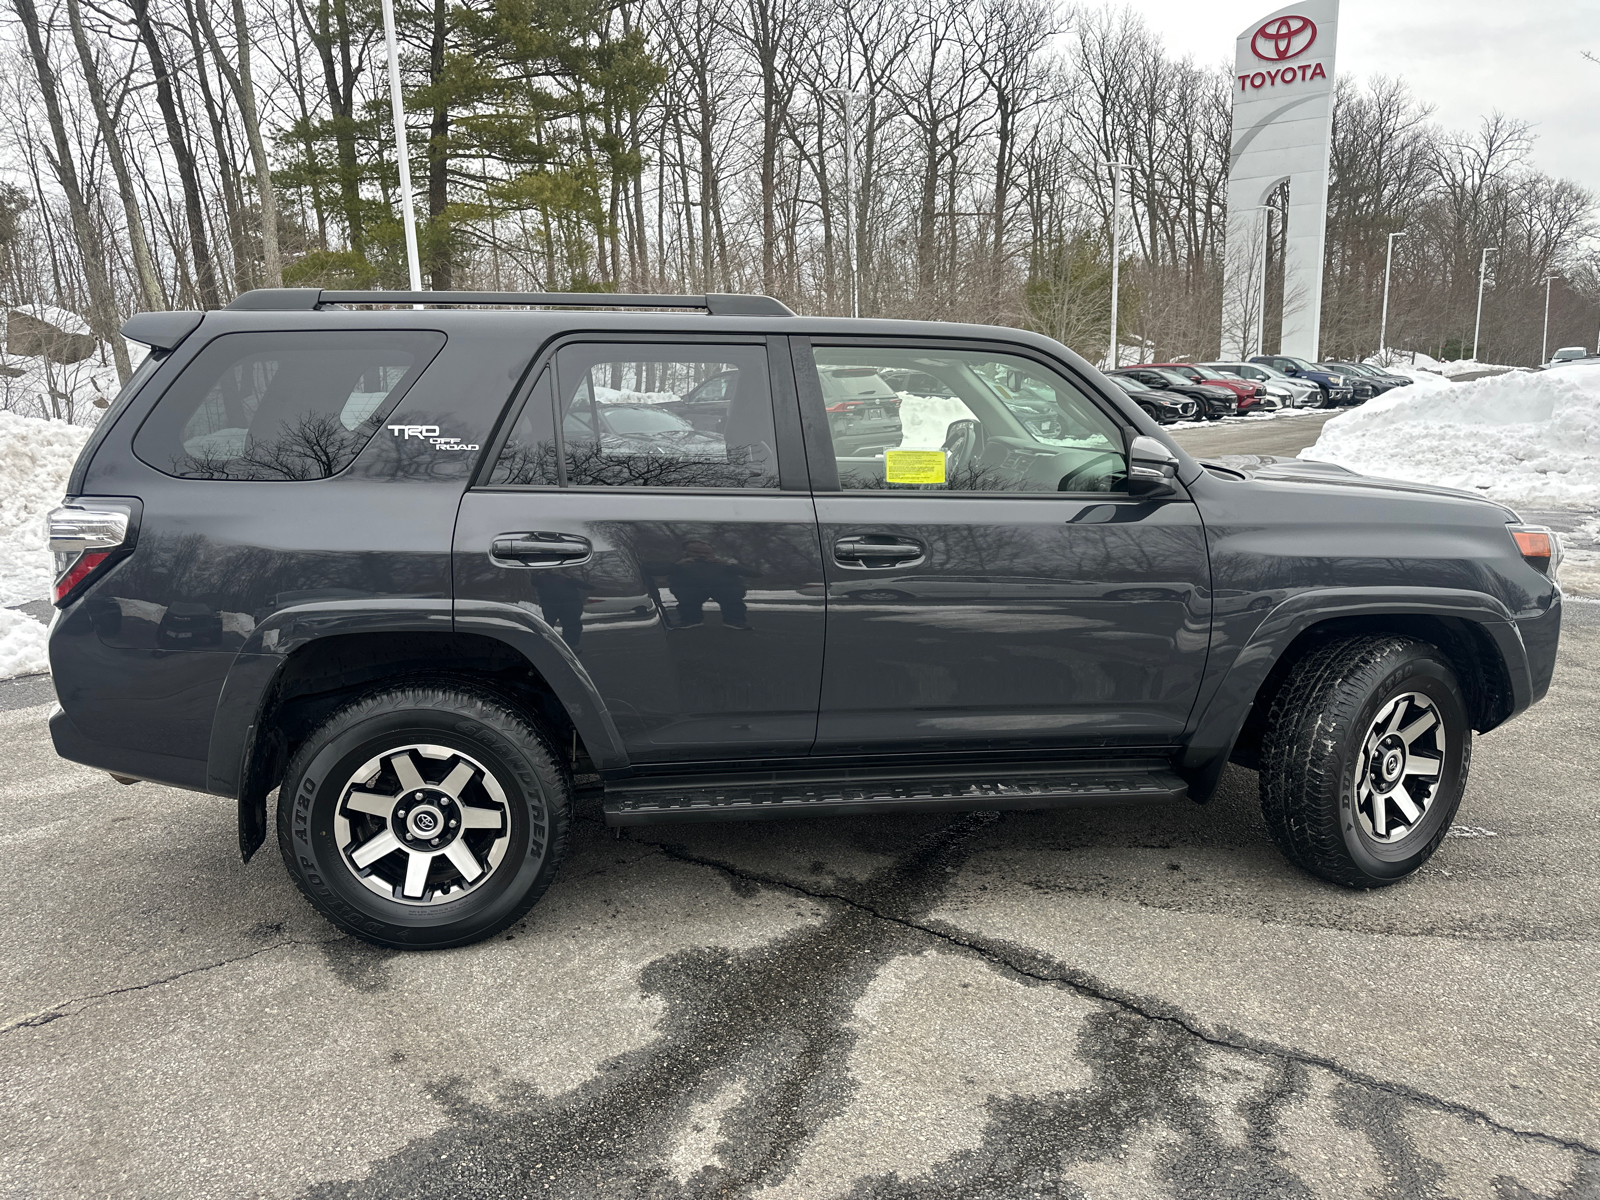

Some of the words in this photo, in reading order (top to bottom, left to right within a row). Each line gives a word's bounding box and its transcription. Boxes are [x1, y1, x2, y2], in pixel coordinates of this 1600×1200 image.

[1238, 62, 1326, 91] TOYOTA
[387, 425, 440, 440] TRD
[455, 721, 546, 860] GRANDTREK
[299, 856, 386, 934] DUNLOP
